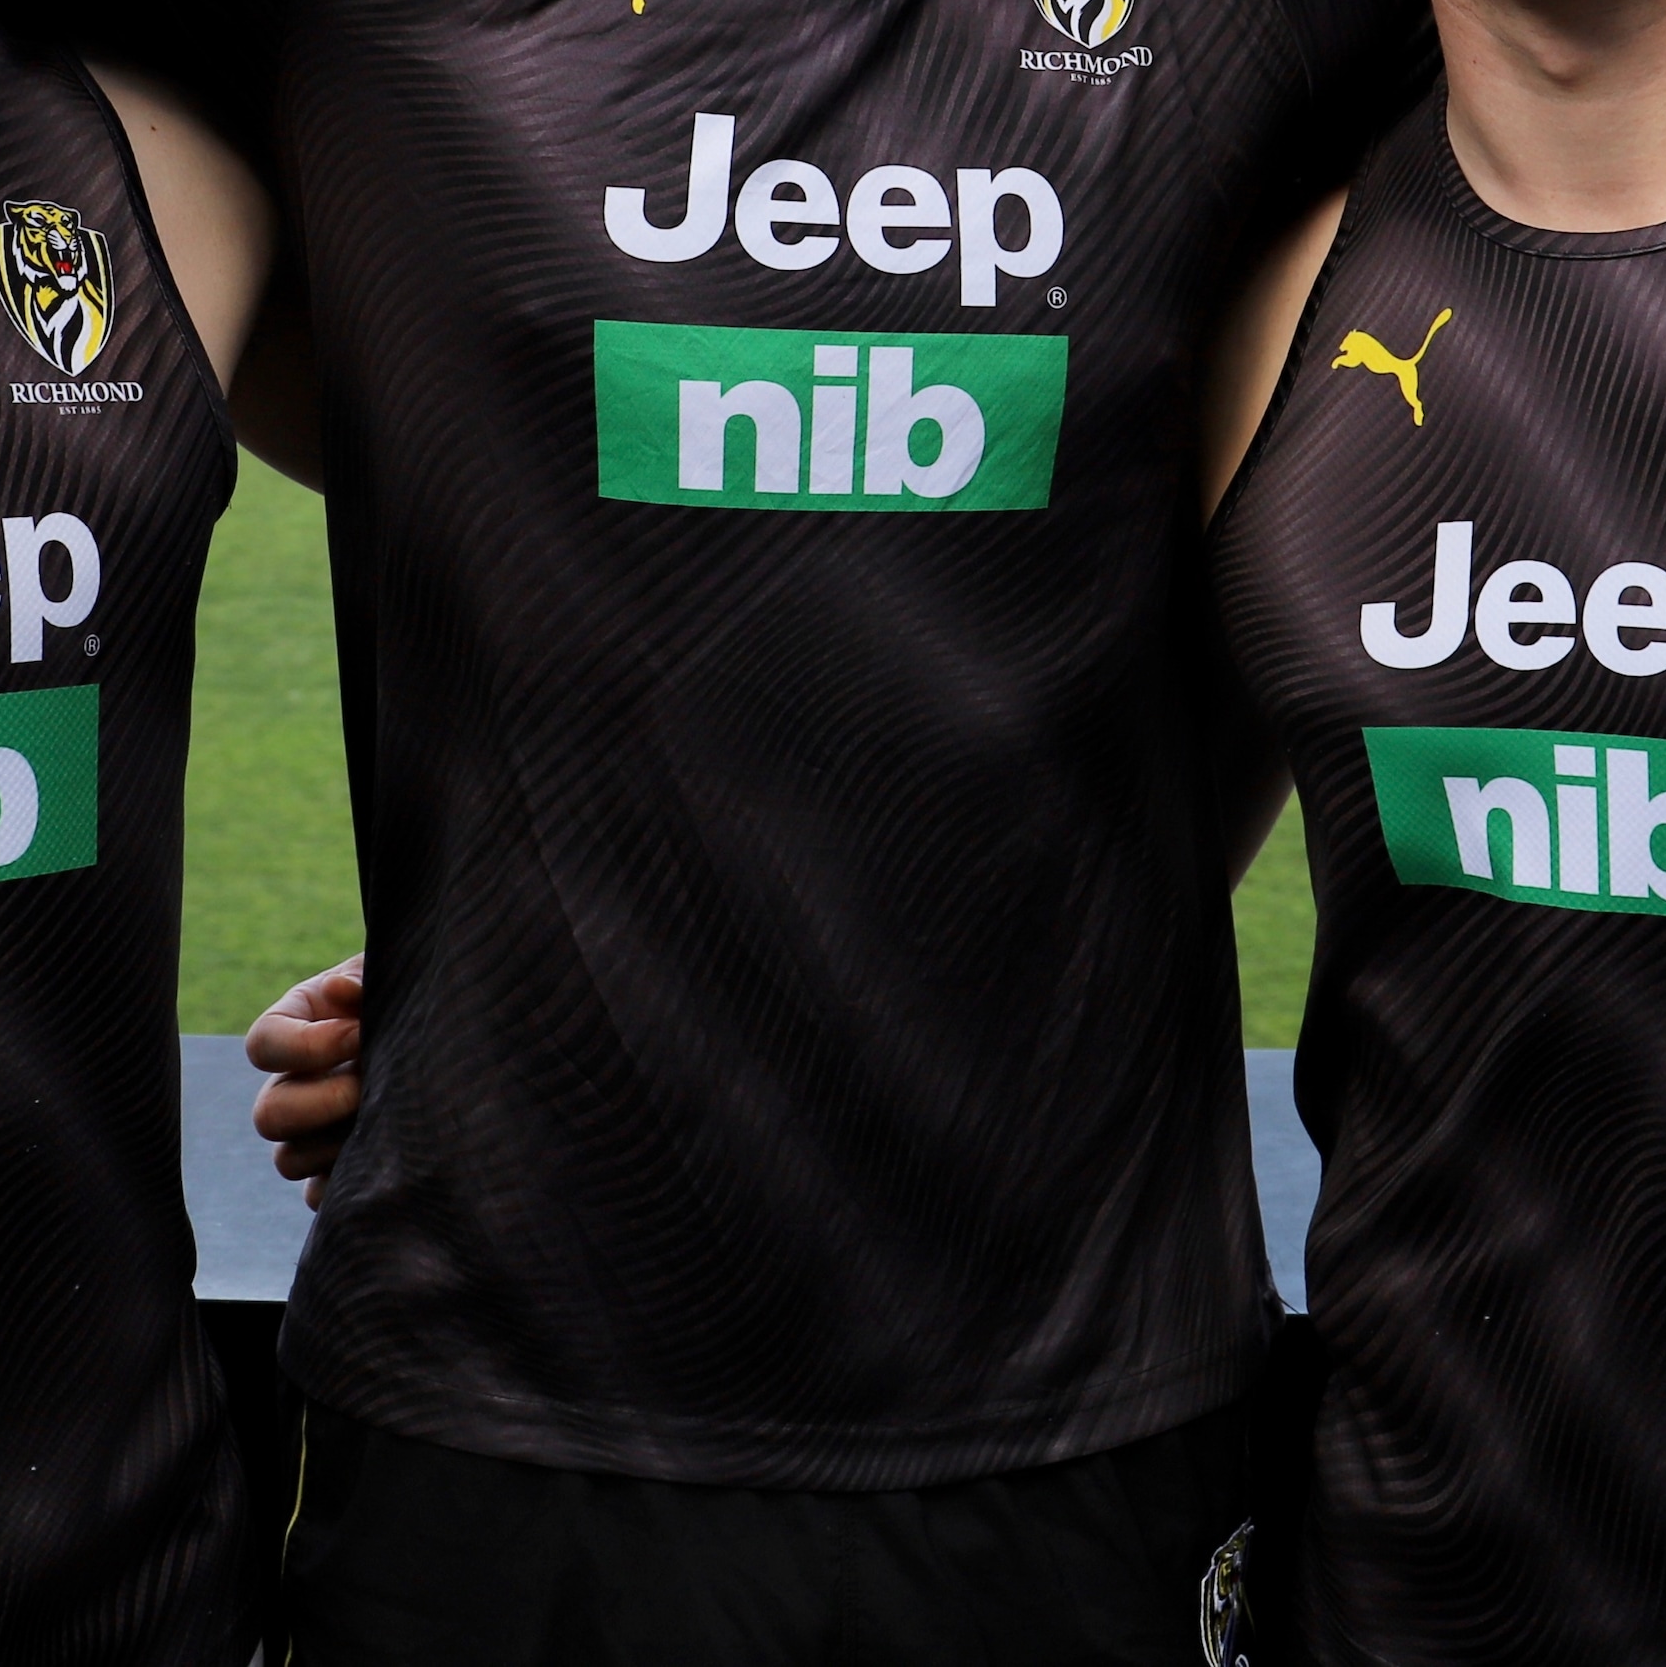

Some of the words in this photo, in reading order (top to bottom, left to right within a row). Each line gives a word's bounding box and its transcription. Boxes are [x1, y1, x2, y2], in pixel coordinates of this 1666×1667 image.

[1019, 45, 1154, 75] RICHMOND
[1070, 73, 1088, 84] EST
[604, 112, 1064, 307] Jeep
[8, 381, 145, 404] RICHMOND
[58, 405, 78, 416] EST
[678, 345, 986, 499] nib
